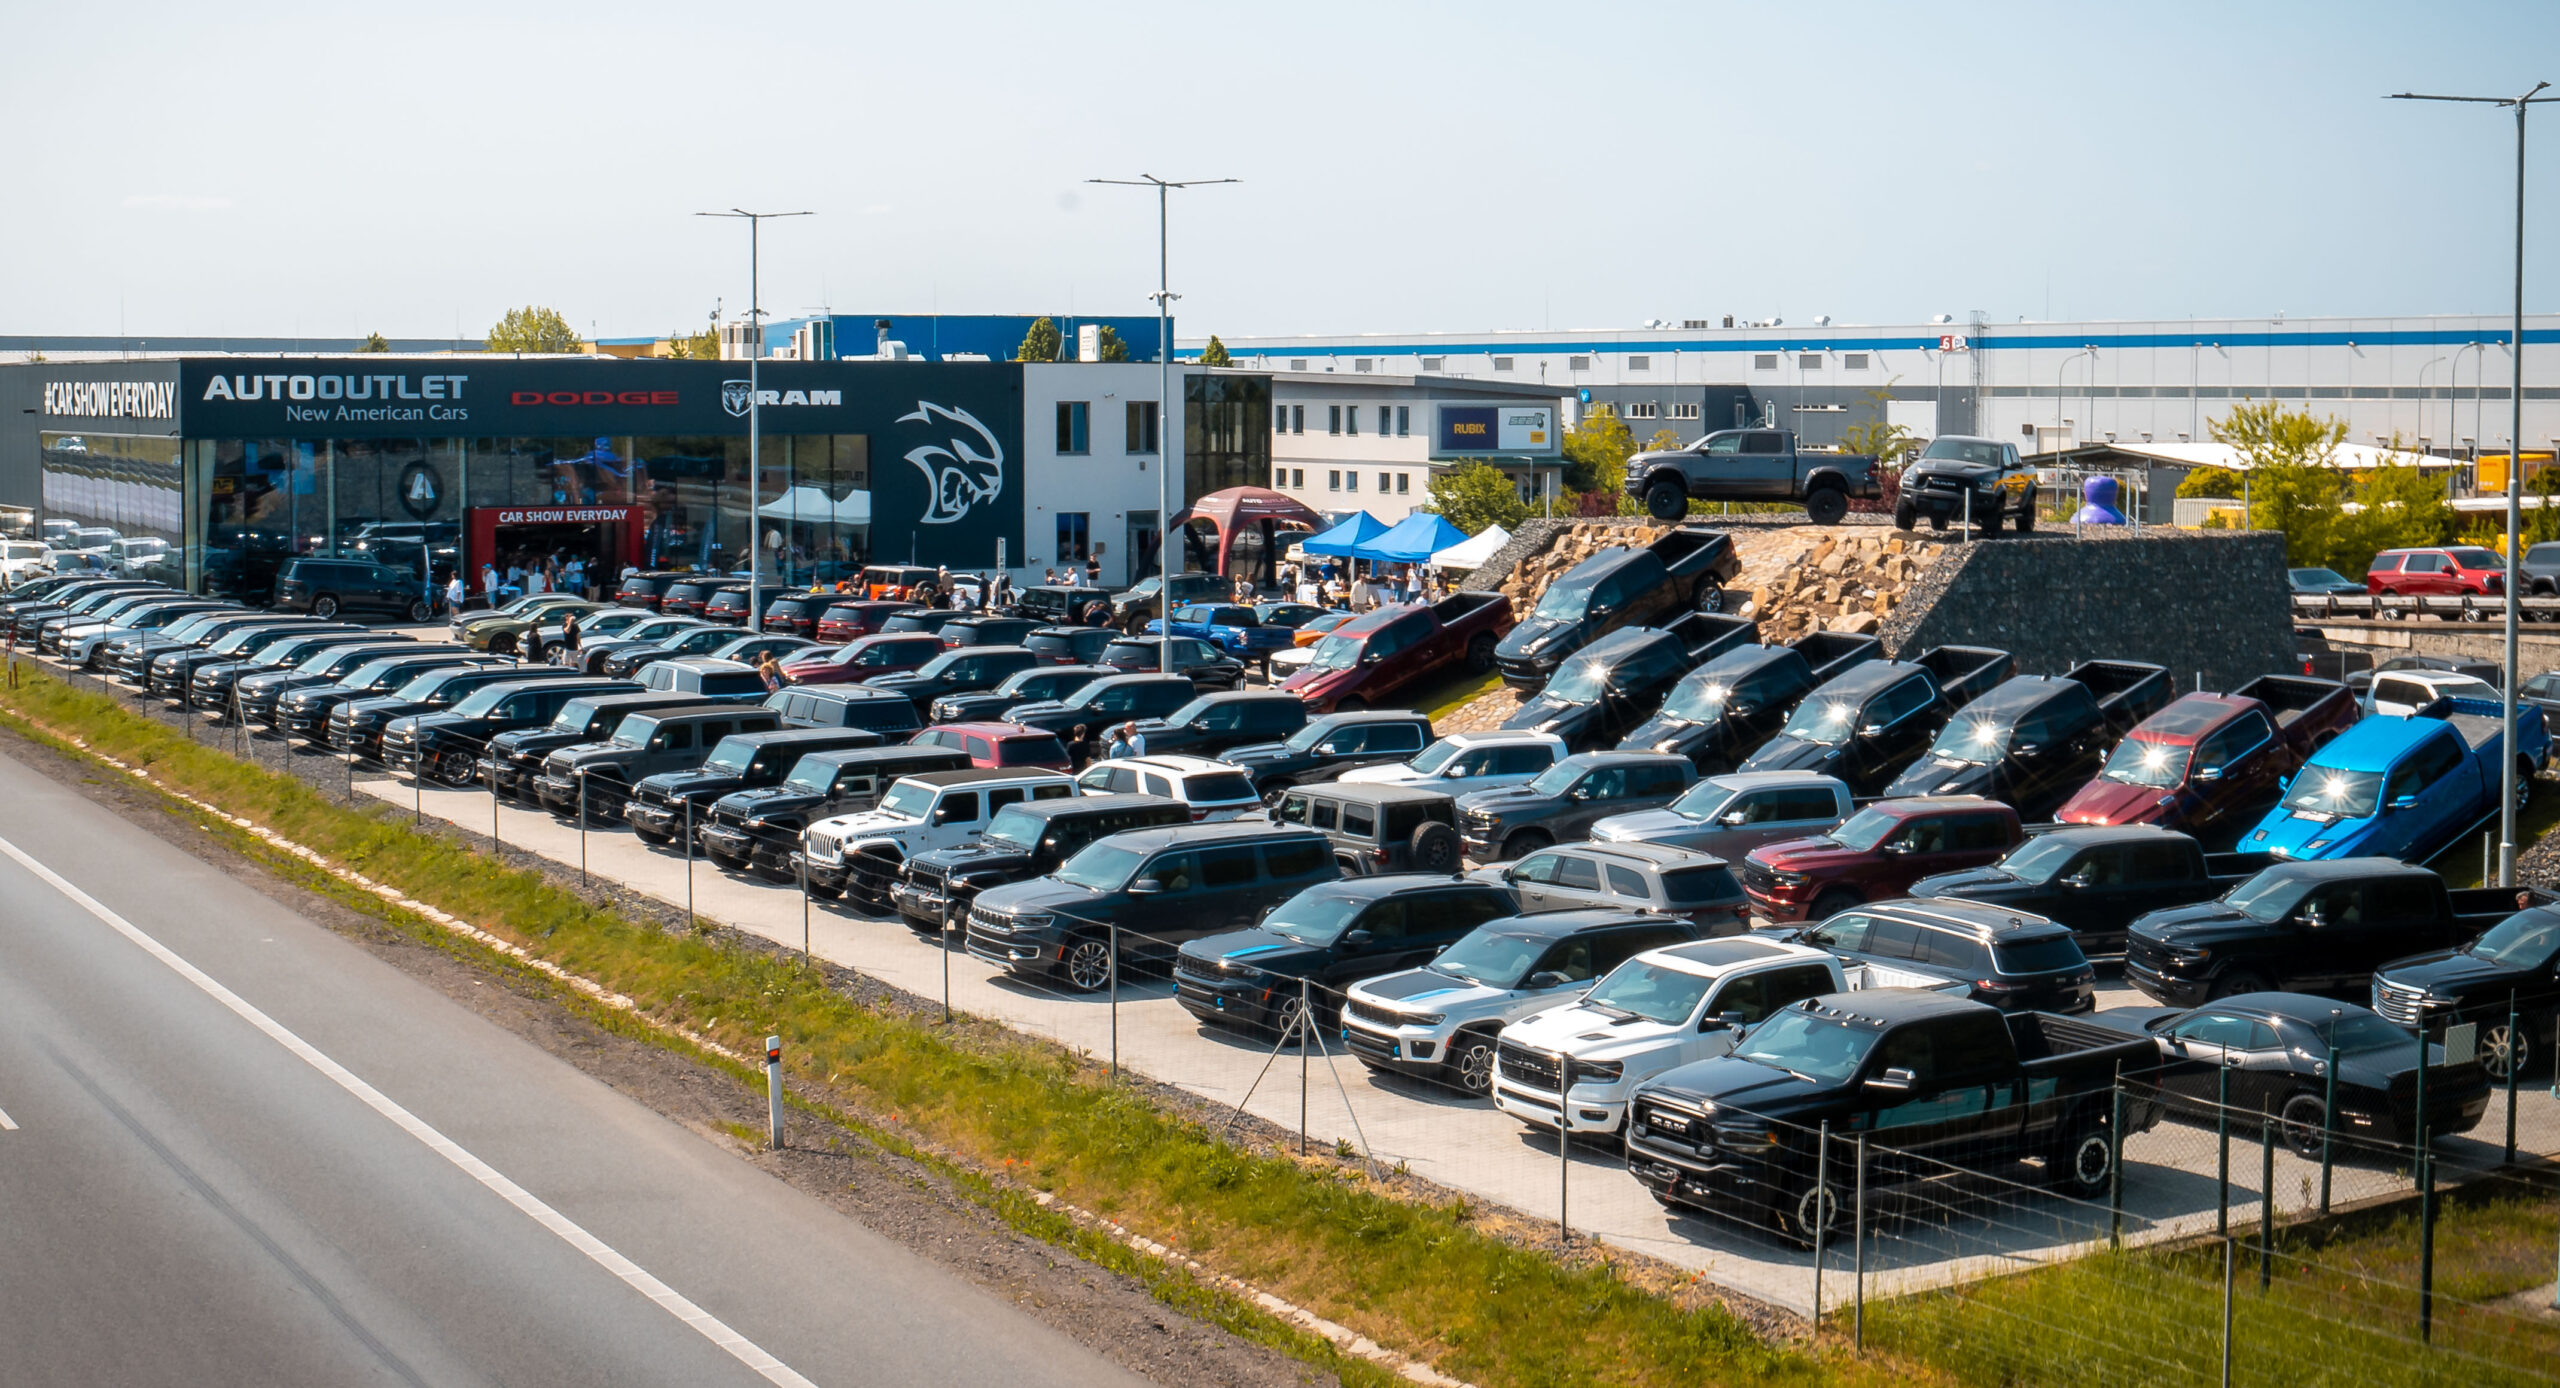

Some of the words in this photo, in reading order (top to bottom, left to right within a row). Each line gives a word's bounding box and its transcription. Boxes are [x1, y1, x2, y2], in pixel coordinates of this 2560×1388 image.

[203, 375, 469, 400] AUTOOUTLET
[511, 391, 679, 405] DODGE
[756, 390, 842, 405] RAM
[286, 406, 329, 421] New
[335, 404, 423, 421] American
[429, 405, 468, 420] Cars
[1453, 423, 1486, 434] RUBIX
[499, 512, 523, 522] CAR
[526, 511, 564, 522] SHOW
[566, 509, 627, 521] EVERYDAY
[857, 830, 906, 839] RUBICON
